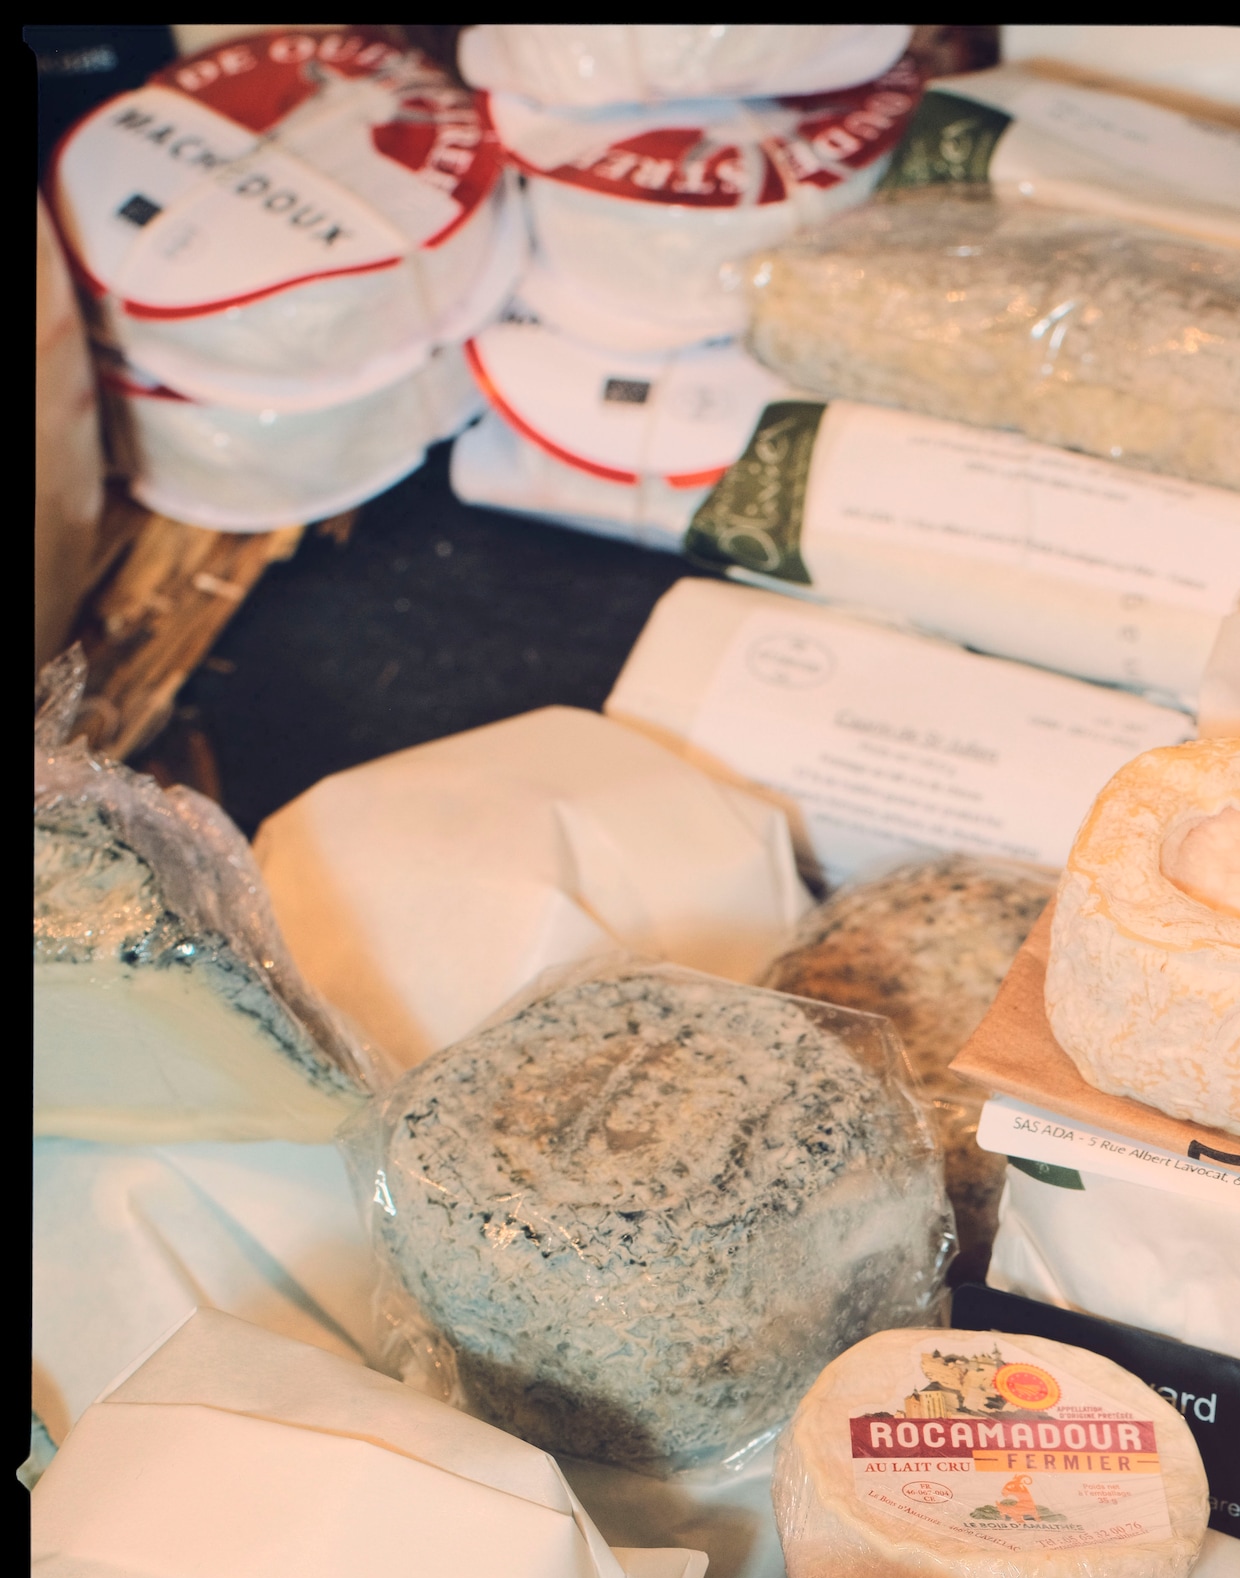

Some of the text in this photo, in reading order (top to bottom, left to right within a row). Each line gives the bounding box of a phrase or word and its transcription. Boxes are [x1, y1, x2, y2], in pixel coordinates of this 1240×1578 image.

[1013, 1116, 1038, 1133] SAS
[1041, 1125, 1074, 1141] ADA
[1088, 1137, 1096, 1146] 5
[1101, 1140, 1126, 1154] Rue
[1129, 1149, 1171, 1167] Albert
[869, 1421, 1143, 1451] ROCAMADOUR
[865, 1462, 971, 1473] AU LAIT CRU
[1007, 1453, 1131, 1471] FERMIER
